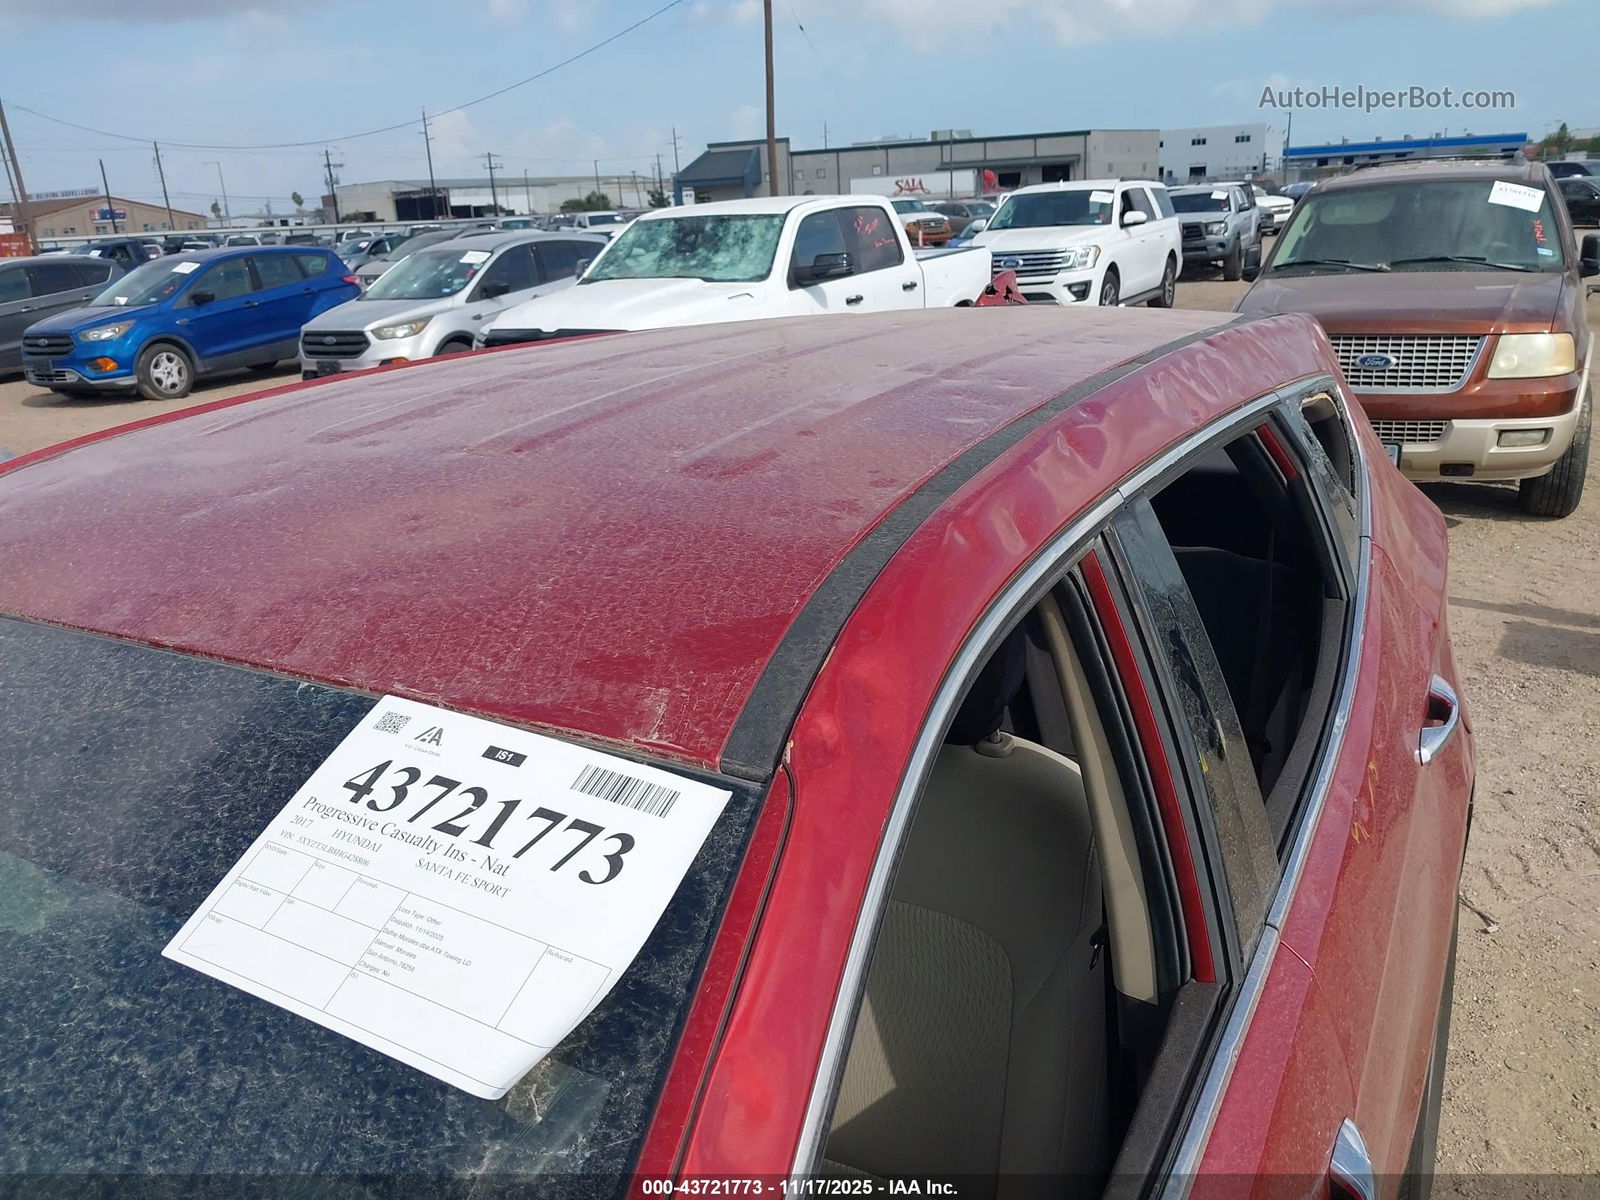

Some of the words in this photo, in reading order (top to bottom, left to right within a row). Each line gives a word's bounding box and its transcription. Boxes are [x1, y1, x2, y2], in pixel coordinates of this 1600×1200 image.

[895, 178, 929, 195] SAIA
[496, 749, 514, 762] IS1
[302, 796, 379, 831] Progressive
[380, 822, 443, 855] Casualty
[443, 843, 468, 862] Ins
[480, 855, 511, 877] Nat
[343, 760, 635, 885] 43721773
[290, 814, 314, 829] 2017
[331, 828, 383, 853] HYUNDAI
[415, 858, 453, 879] SANTA
[455, 871, 472, 885] FE
[471, 877, 511, 898] SPORT
[443, 951, 462, 965] Towing
